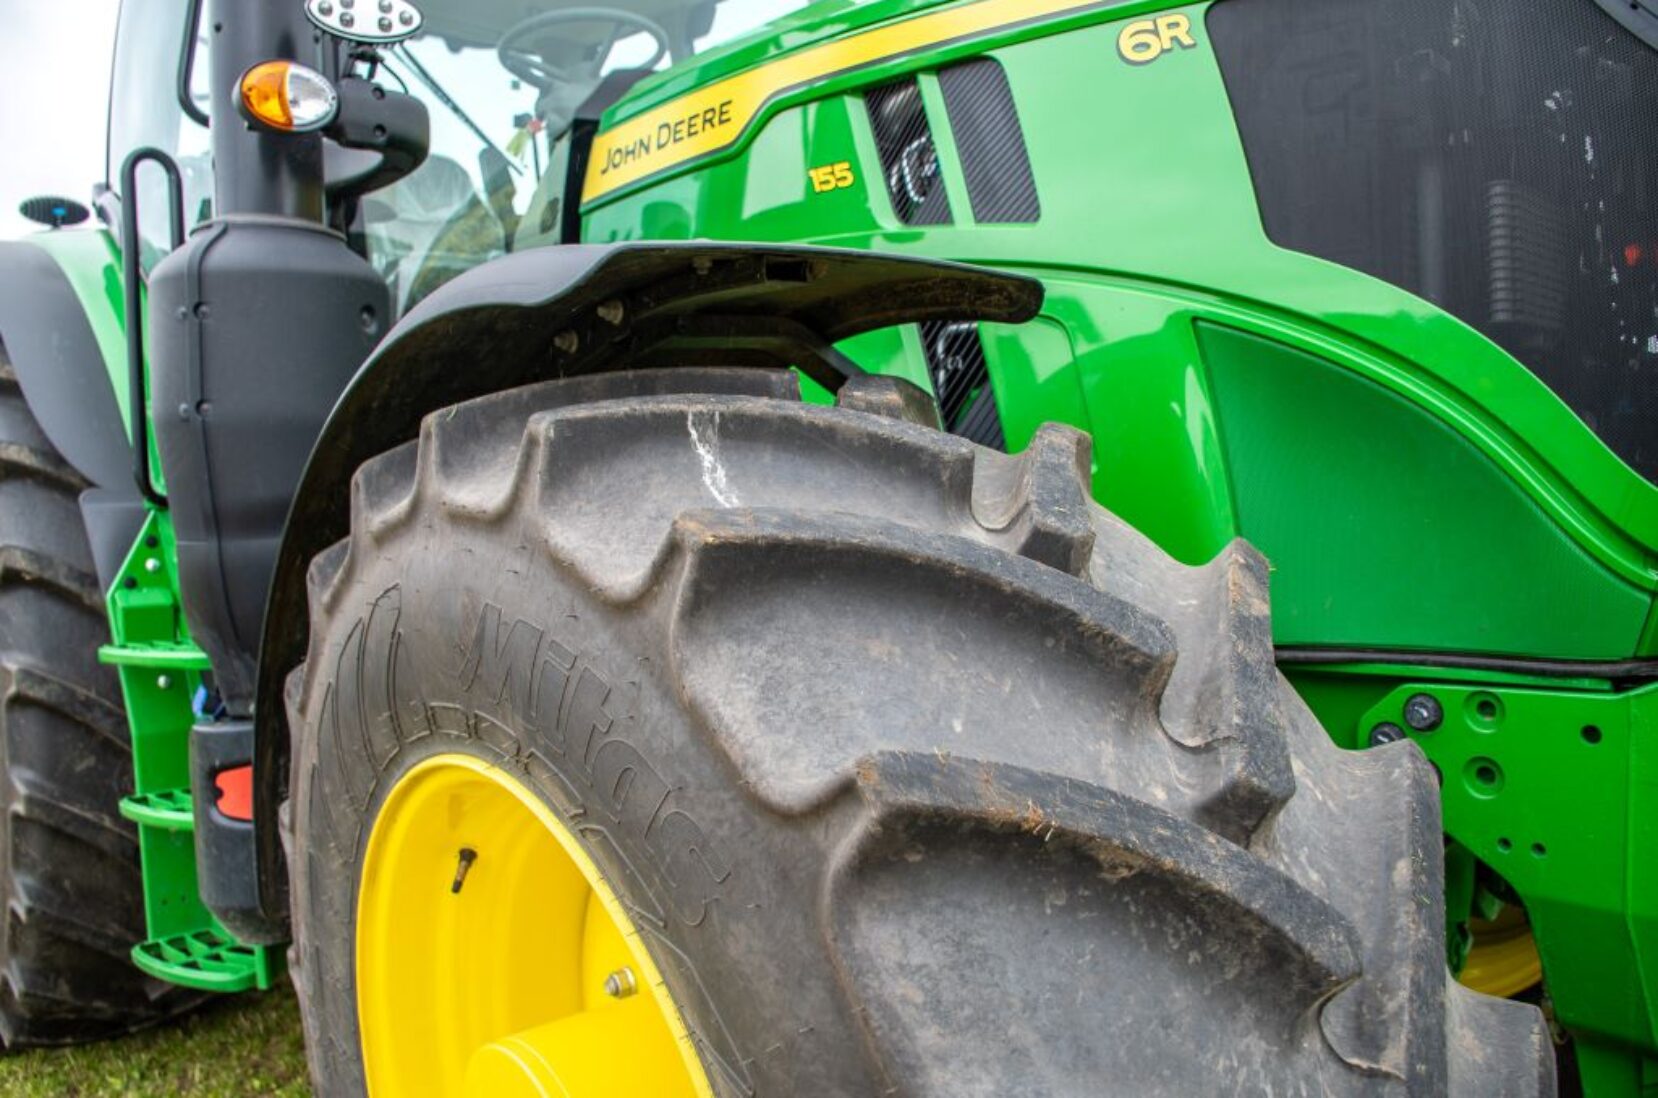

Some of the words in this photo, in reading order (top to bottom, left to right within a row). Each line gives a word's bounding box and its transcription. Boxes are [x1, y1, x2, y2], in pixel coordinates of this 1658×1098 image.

[1116, 13, 1197, 66] 6R
[600, 134, 652, 175] JOHN
[656, 99, 733, 151] DEERE
[807, 160, 855, 193] 155
